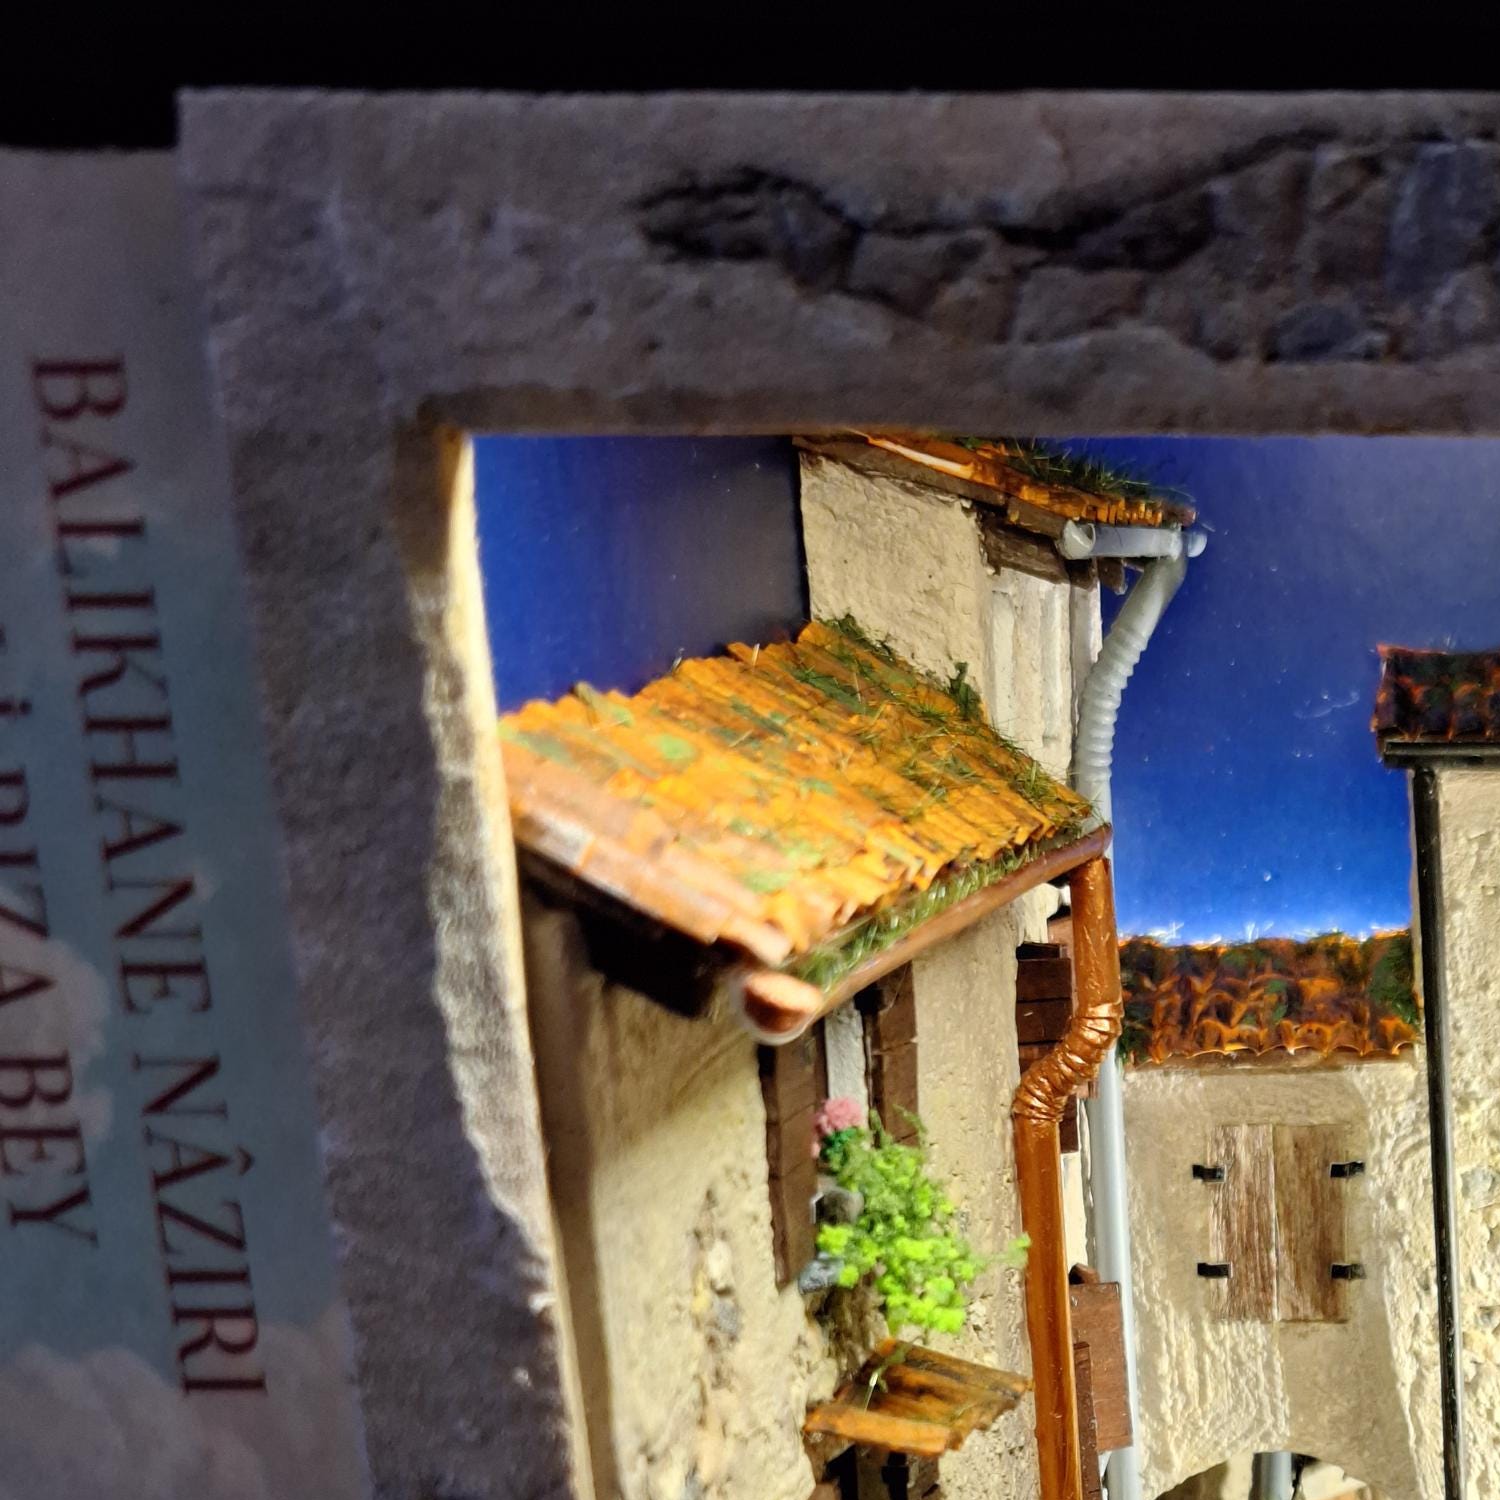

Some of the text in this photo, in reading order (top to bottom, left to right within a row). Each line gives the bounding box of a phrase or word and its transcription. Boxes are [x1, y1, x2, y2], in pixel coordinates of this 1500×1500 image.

[0, 1048, 98, 1248] BEY
[32, 356, 267, 1397] BALIKHANE NÂZIRI
